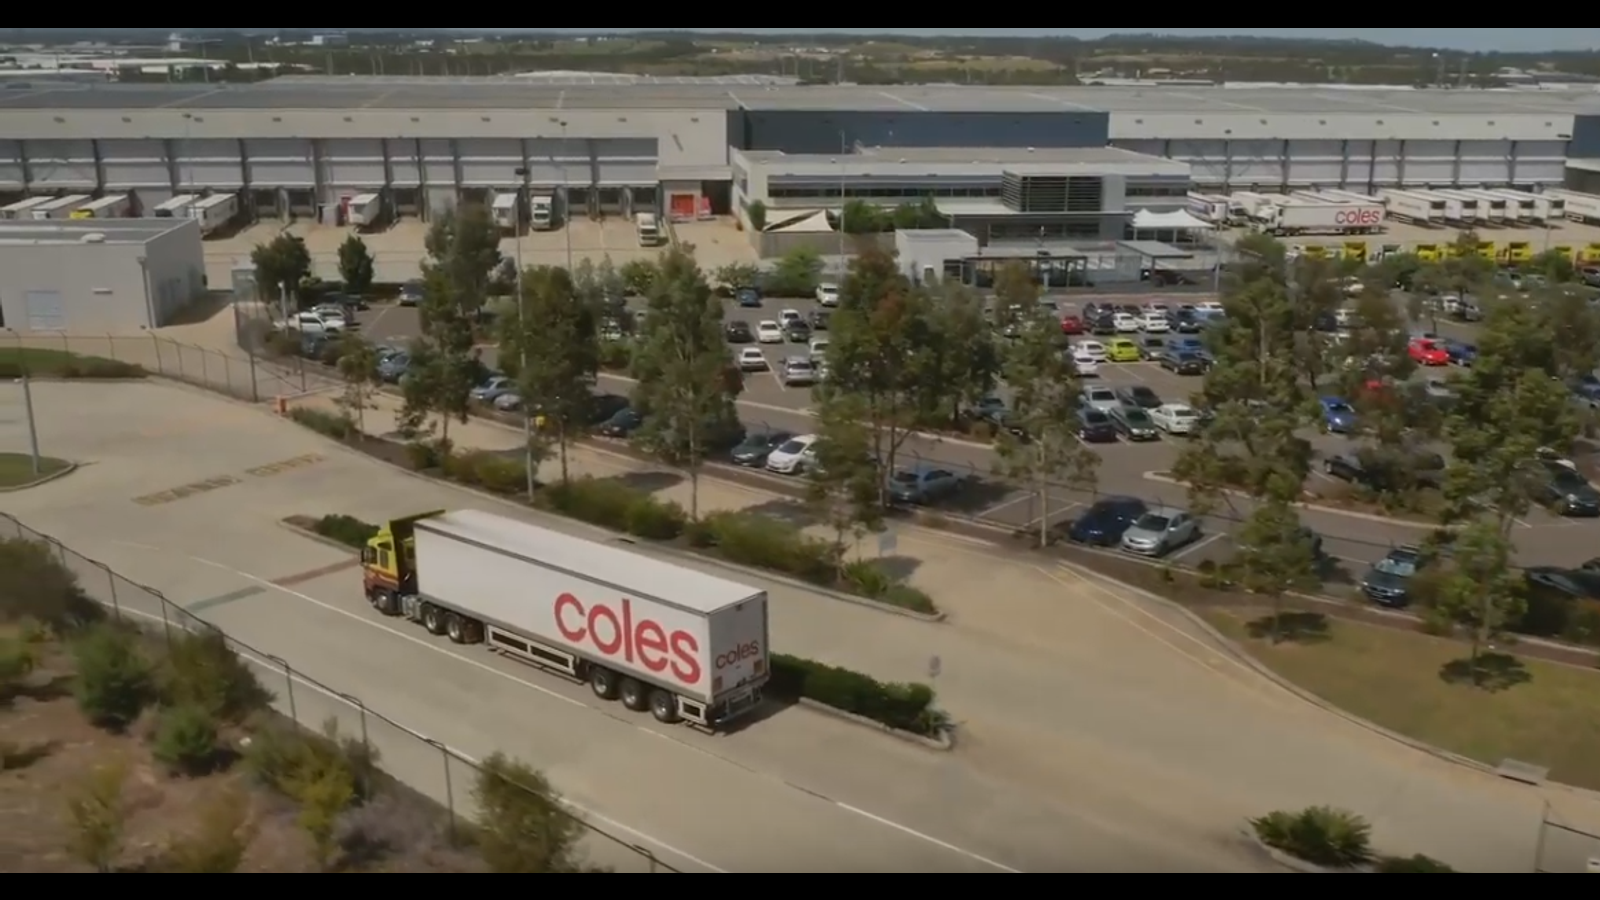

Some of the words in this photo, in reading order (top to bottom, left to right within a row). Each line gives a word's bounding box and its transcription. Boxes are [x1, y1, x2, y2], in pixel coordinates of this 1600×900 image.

[1336, 208, 1380, 224] coles
[555, 593, 701, 684] coles
[716, 640, 759, 669] coles
